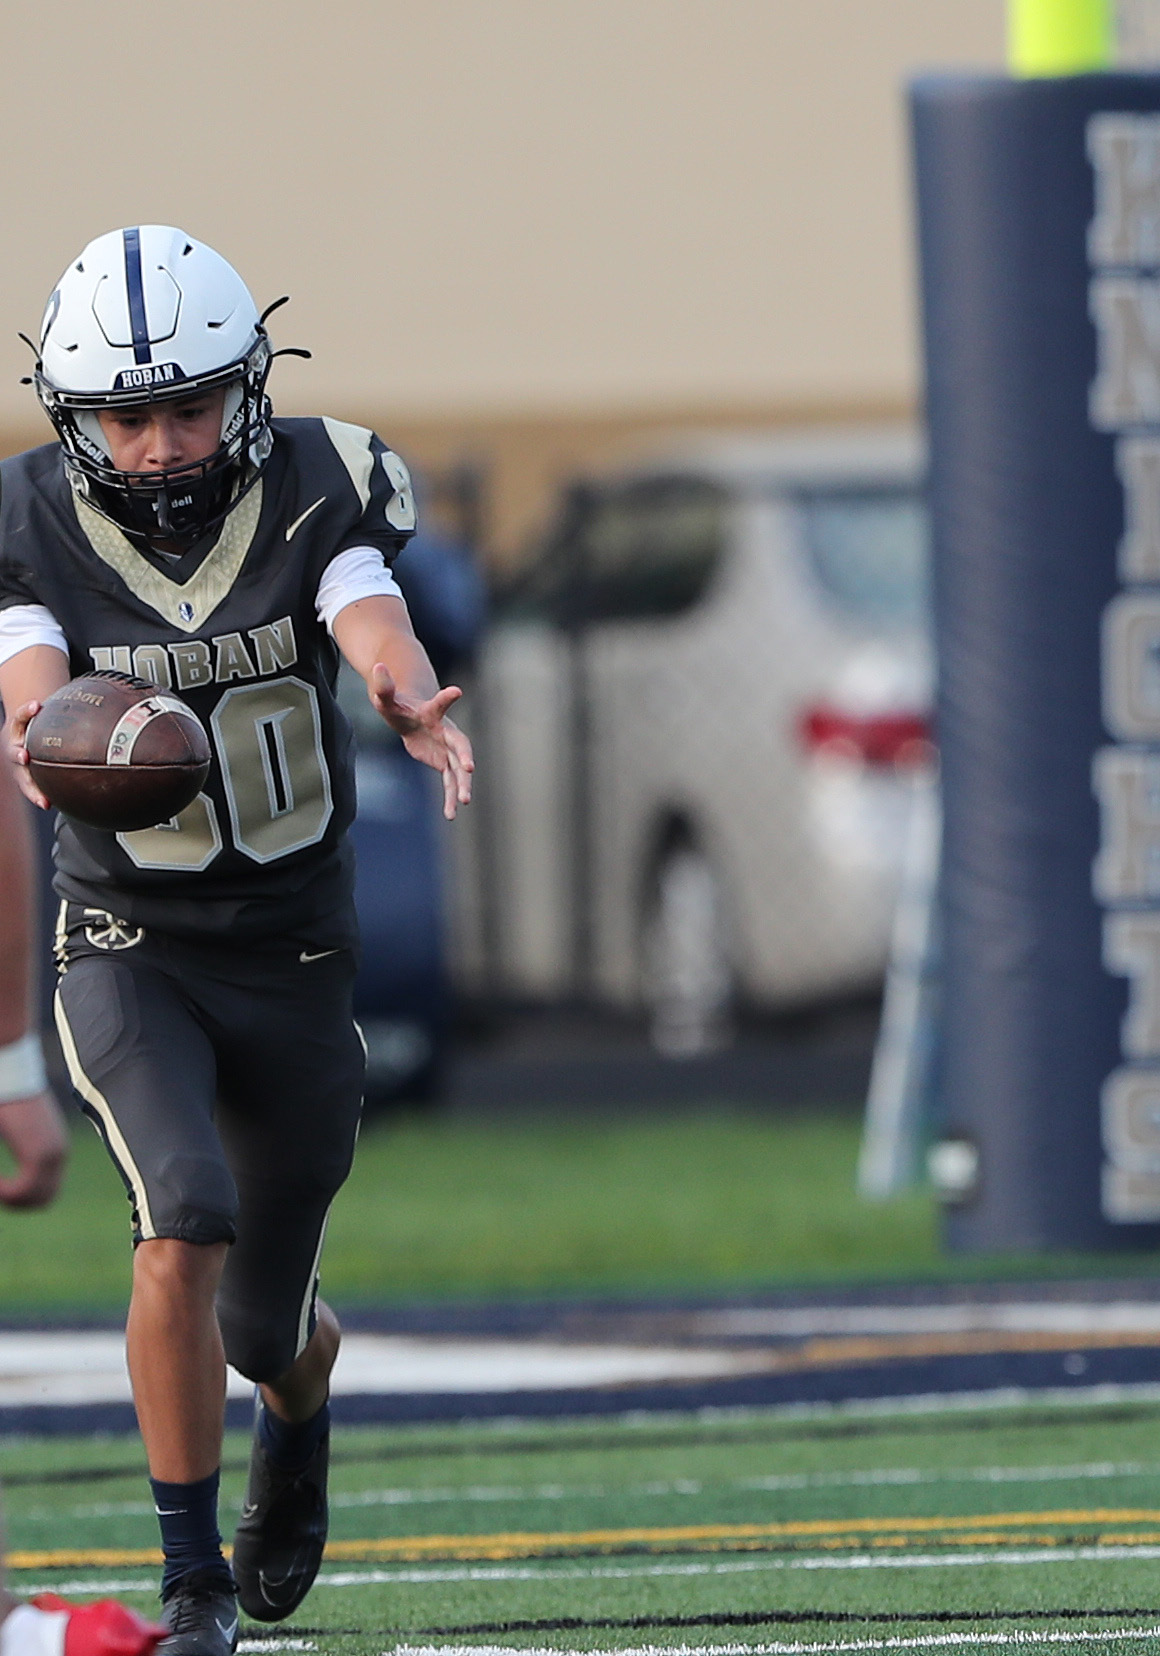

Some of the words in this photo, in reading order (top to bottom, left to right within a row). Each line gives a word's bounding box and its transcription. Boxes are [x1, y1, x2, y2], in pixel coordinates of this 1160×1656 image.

[121, 364, 175, 388] HOBAN
[151, 494, 193, 511] Rdell
[89, 615, 298, 691] HOBAN
[116, 675, 334, 872] 0
